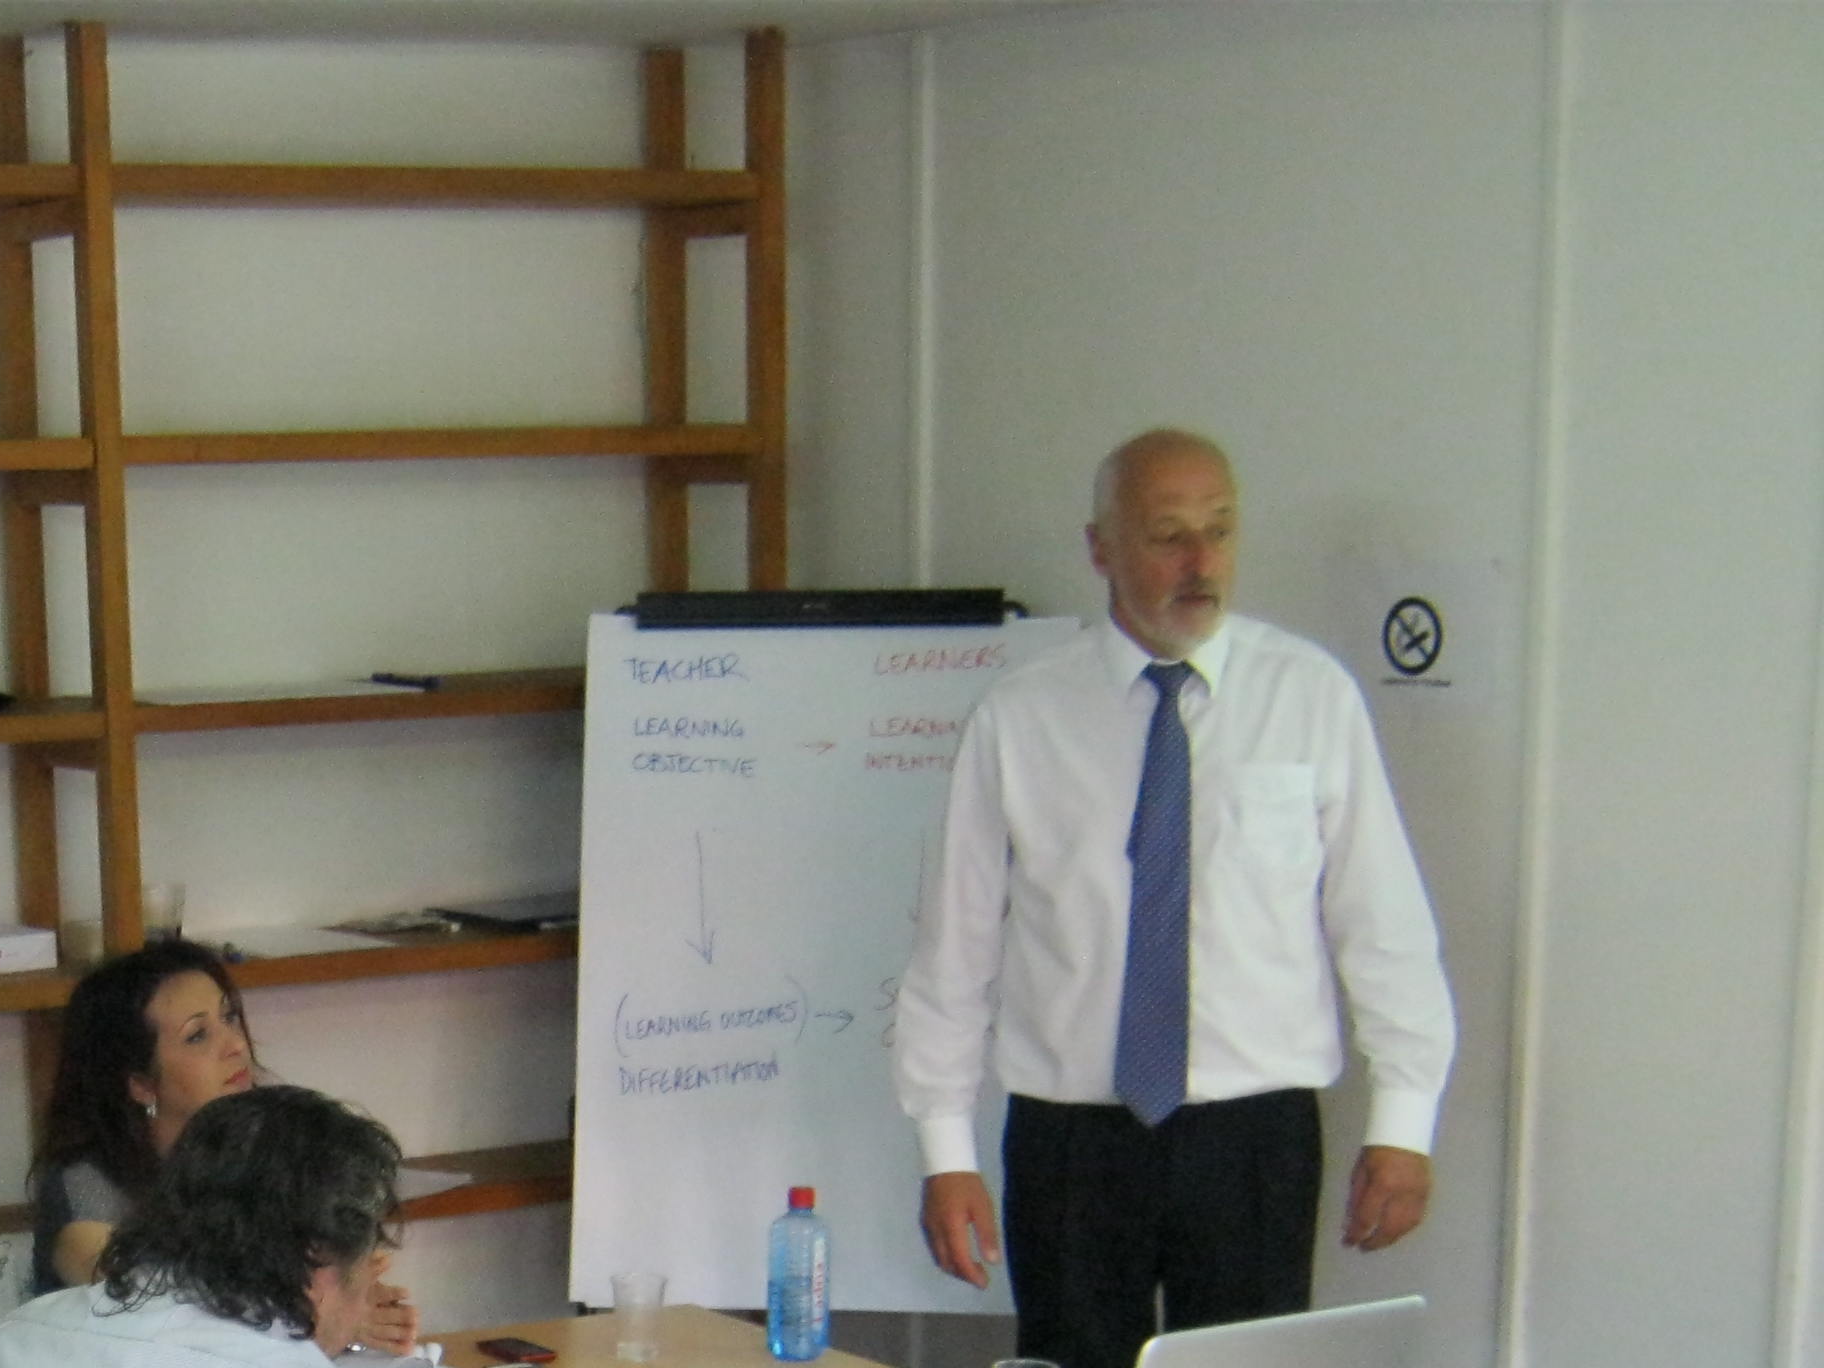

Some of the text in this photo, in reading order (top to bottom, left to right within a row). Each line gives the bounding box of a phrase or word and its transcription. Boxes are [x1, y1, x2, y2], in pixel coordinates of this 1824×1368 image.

[624, 642, 1008, 686] TEACHER LEARNERS
[633, 716, 745, 739] LEARNING
[631, 752, 759, 778] OBJECTIVE
